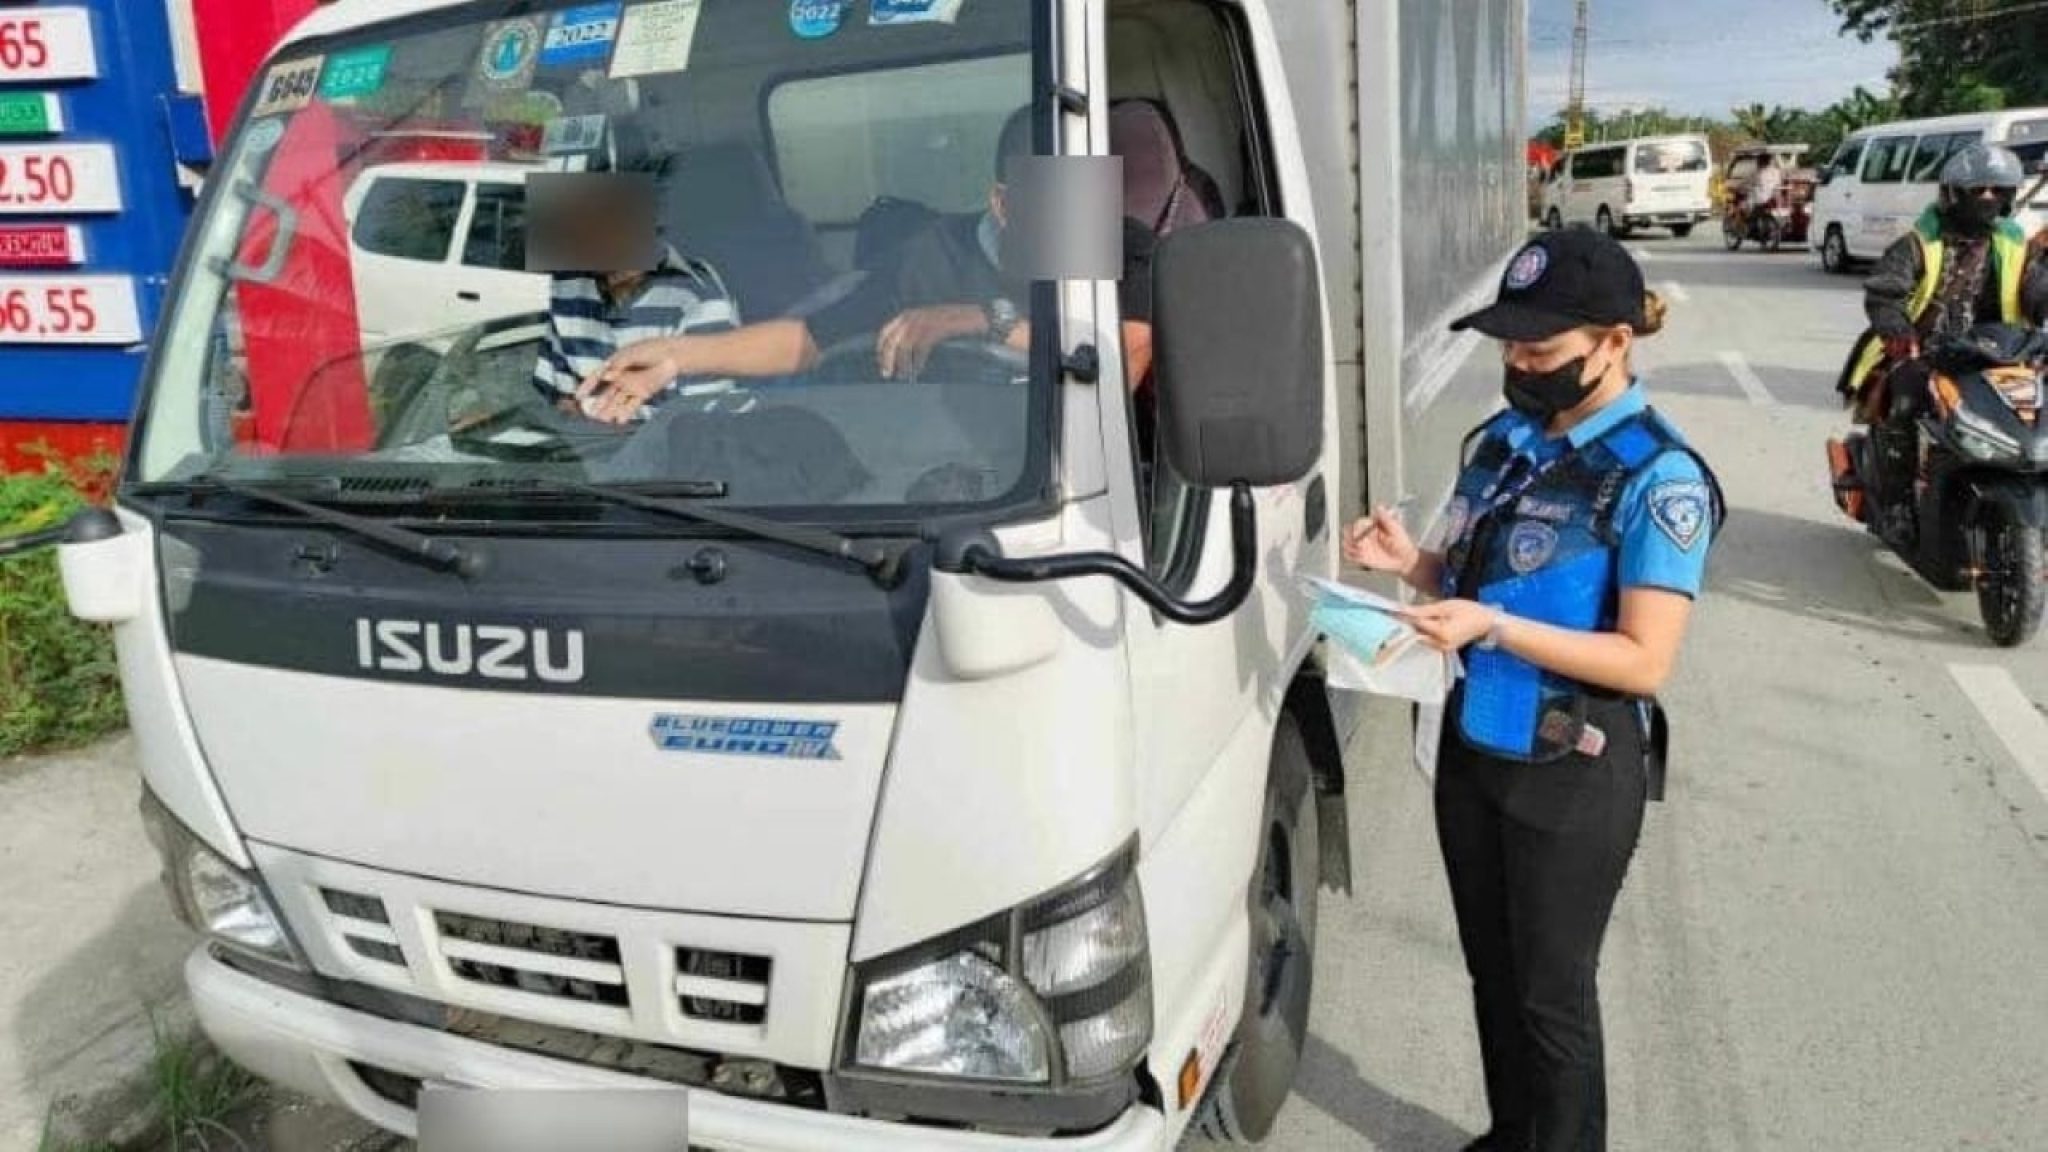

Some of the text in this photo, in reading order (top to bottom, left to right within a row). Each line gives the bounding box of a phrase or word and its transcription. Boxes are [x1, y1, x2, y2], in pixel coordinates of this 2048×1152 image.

[556, 22, 608, 44] 2022
[0, 288, 95, 333] 6.55
[356, 618, 584, 683] ISUZU
